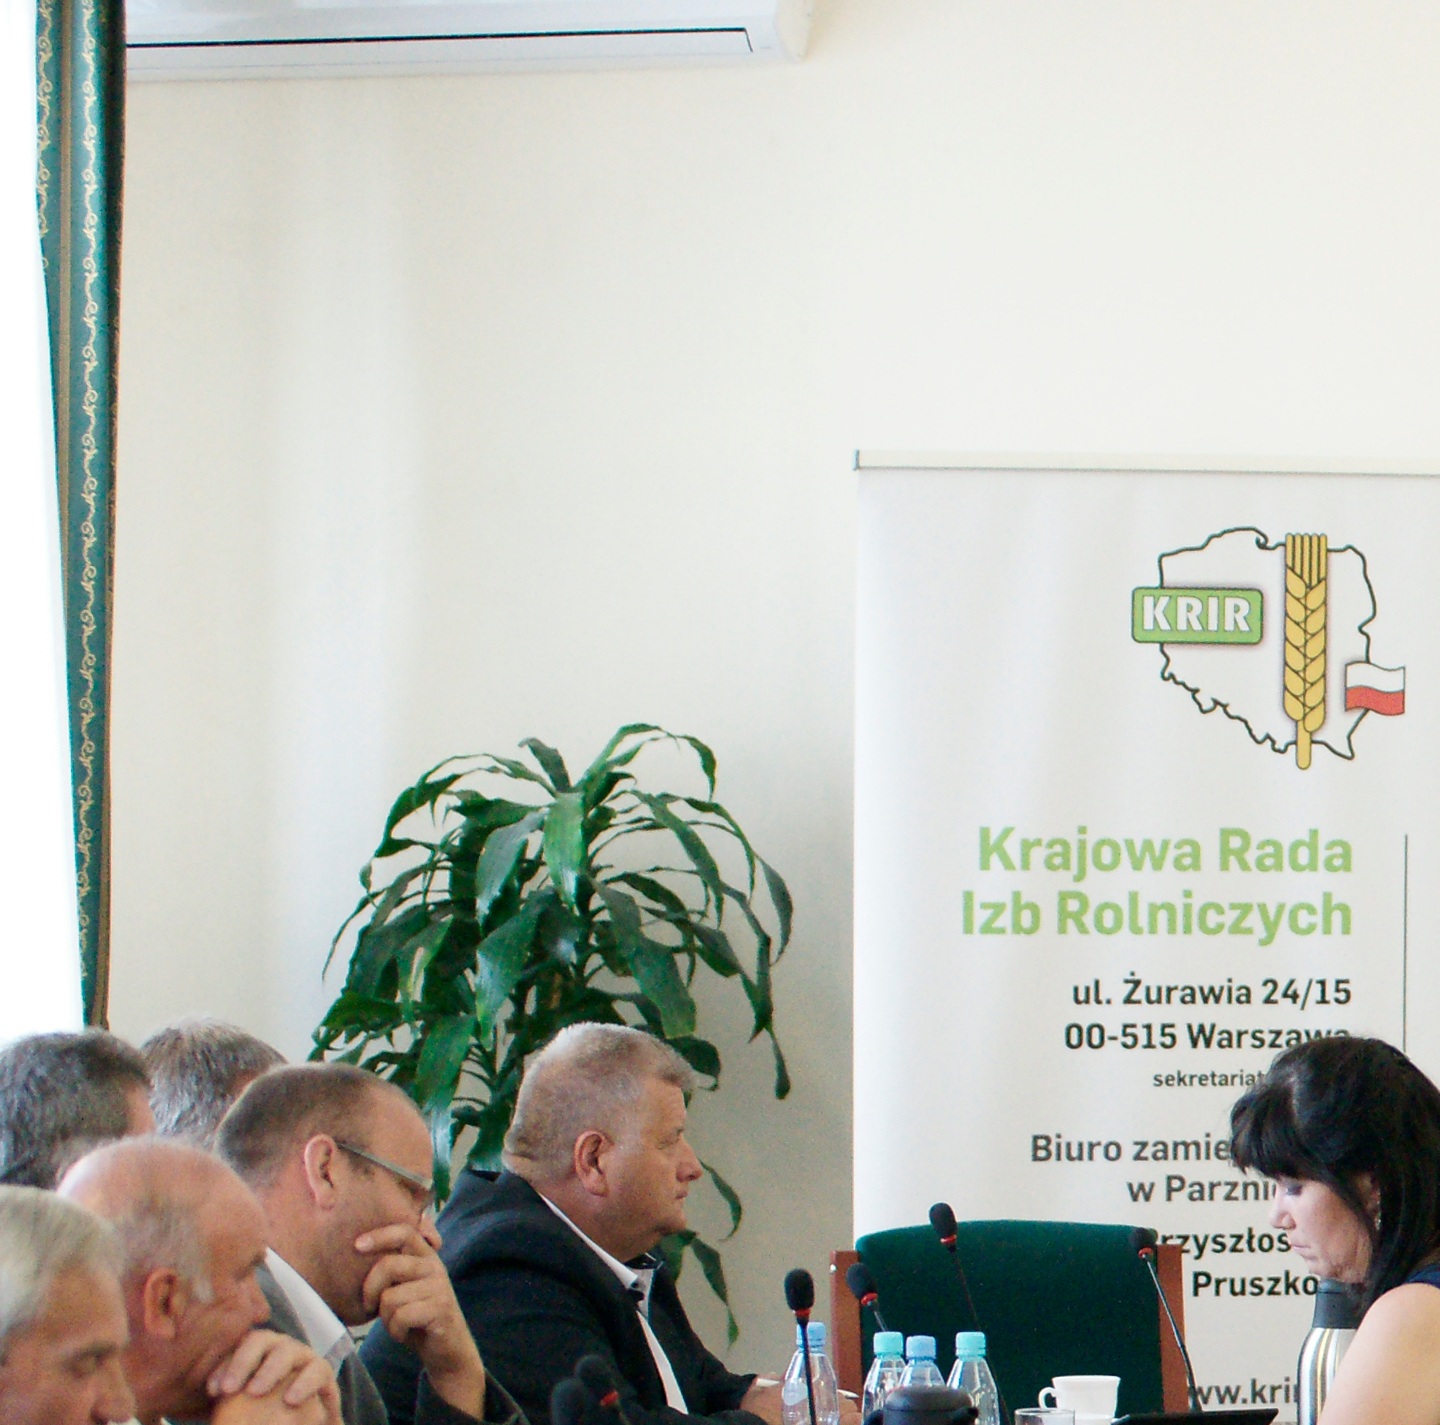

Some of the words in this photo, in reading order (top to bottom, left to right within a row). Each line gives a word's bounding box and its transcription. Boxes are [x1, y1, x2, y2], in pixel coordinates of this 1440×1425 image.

[1143, 595, 1250, 632] KRIR
[978, 825, 1202, 883] Krajowa
[1219, 828, 1352, 873] Rada
[961, 890, 1041, 935] Izb
[1057, 889, 1352, 946] Rolniczych
[1072, 978, 1112, 1005] ul.
[1121, 971, 1252, 1005] Żurawia
[1262, 978, 1352, 1011] 24/15
[1065, 1023, 1177, 1050] 00-515
[1031, 1134, 1122, 1162] Biuro
[1127, 1181, 1155, 1202] w
